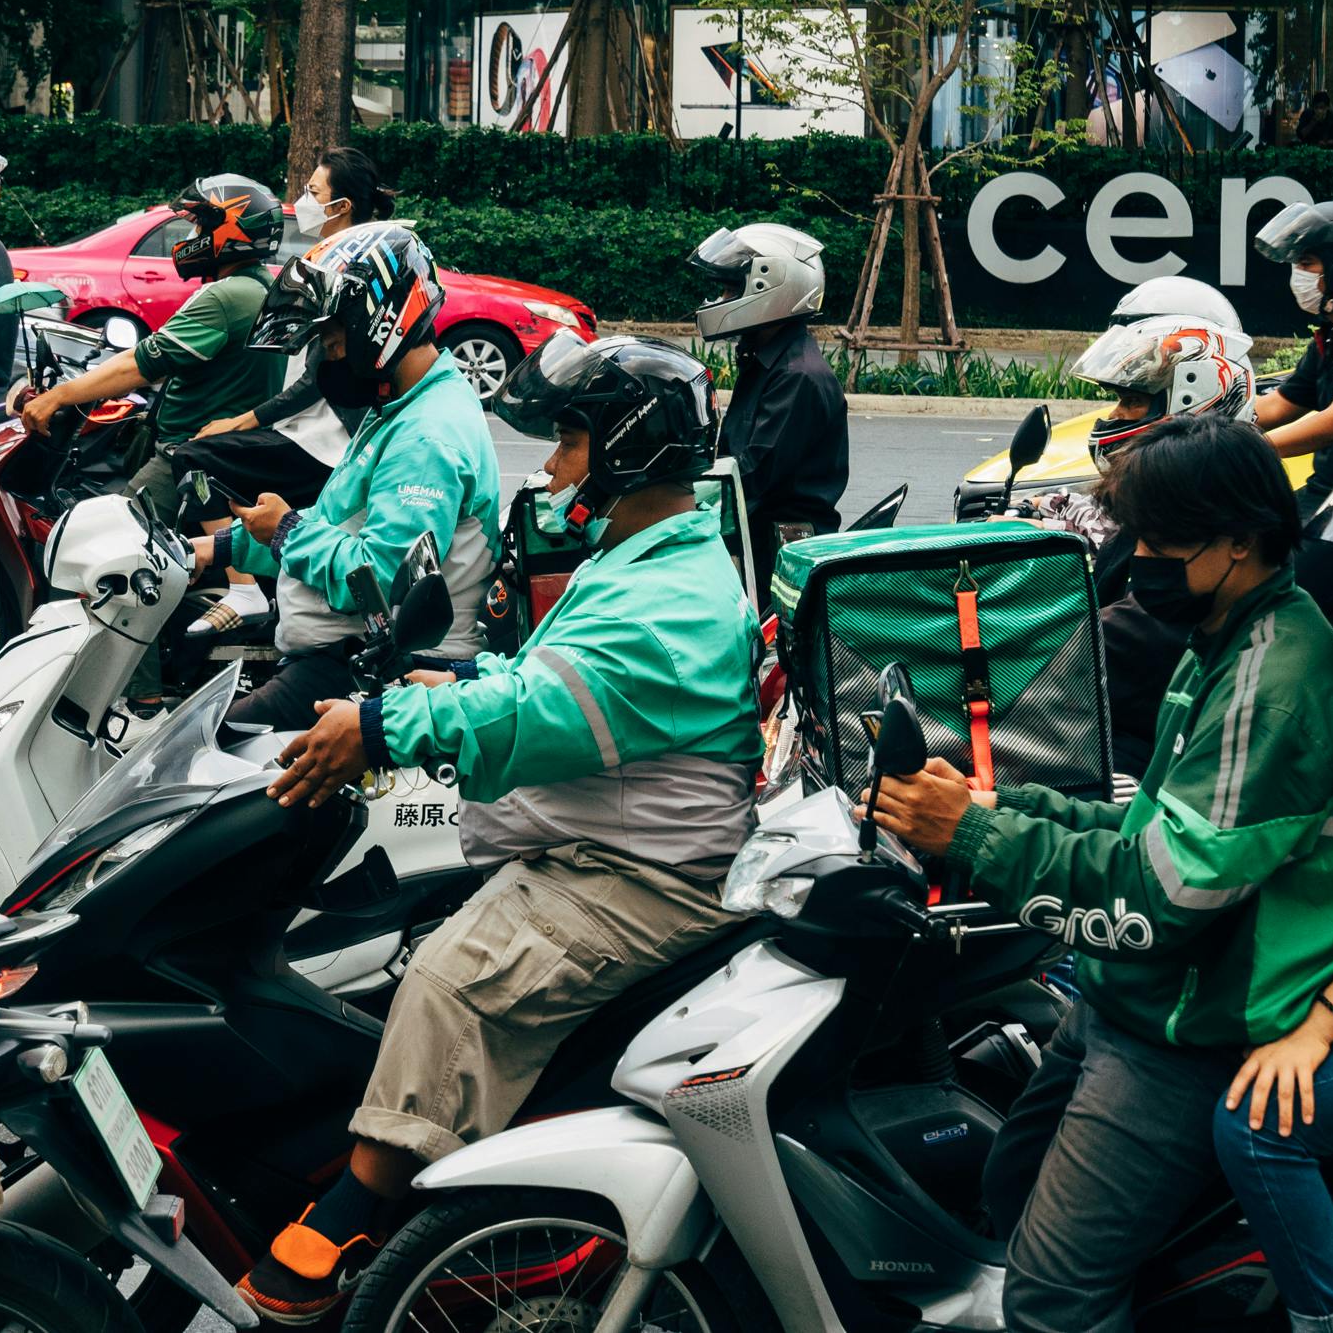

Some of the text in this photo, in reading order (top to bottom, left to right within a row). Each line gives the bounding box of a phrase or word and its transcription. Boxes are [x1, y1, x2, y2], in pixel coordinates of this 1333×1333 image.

[175, 236, 211, 261] RIDER
[371, 301, 398, 347] KYT
[1019, 894, 1154, 950] Grab
[870, 1259, 936, 1274] HONDA
